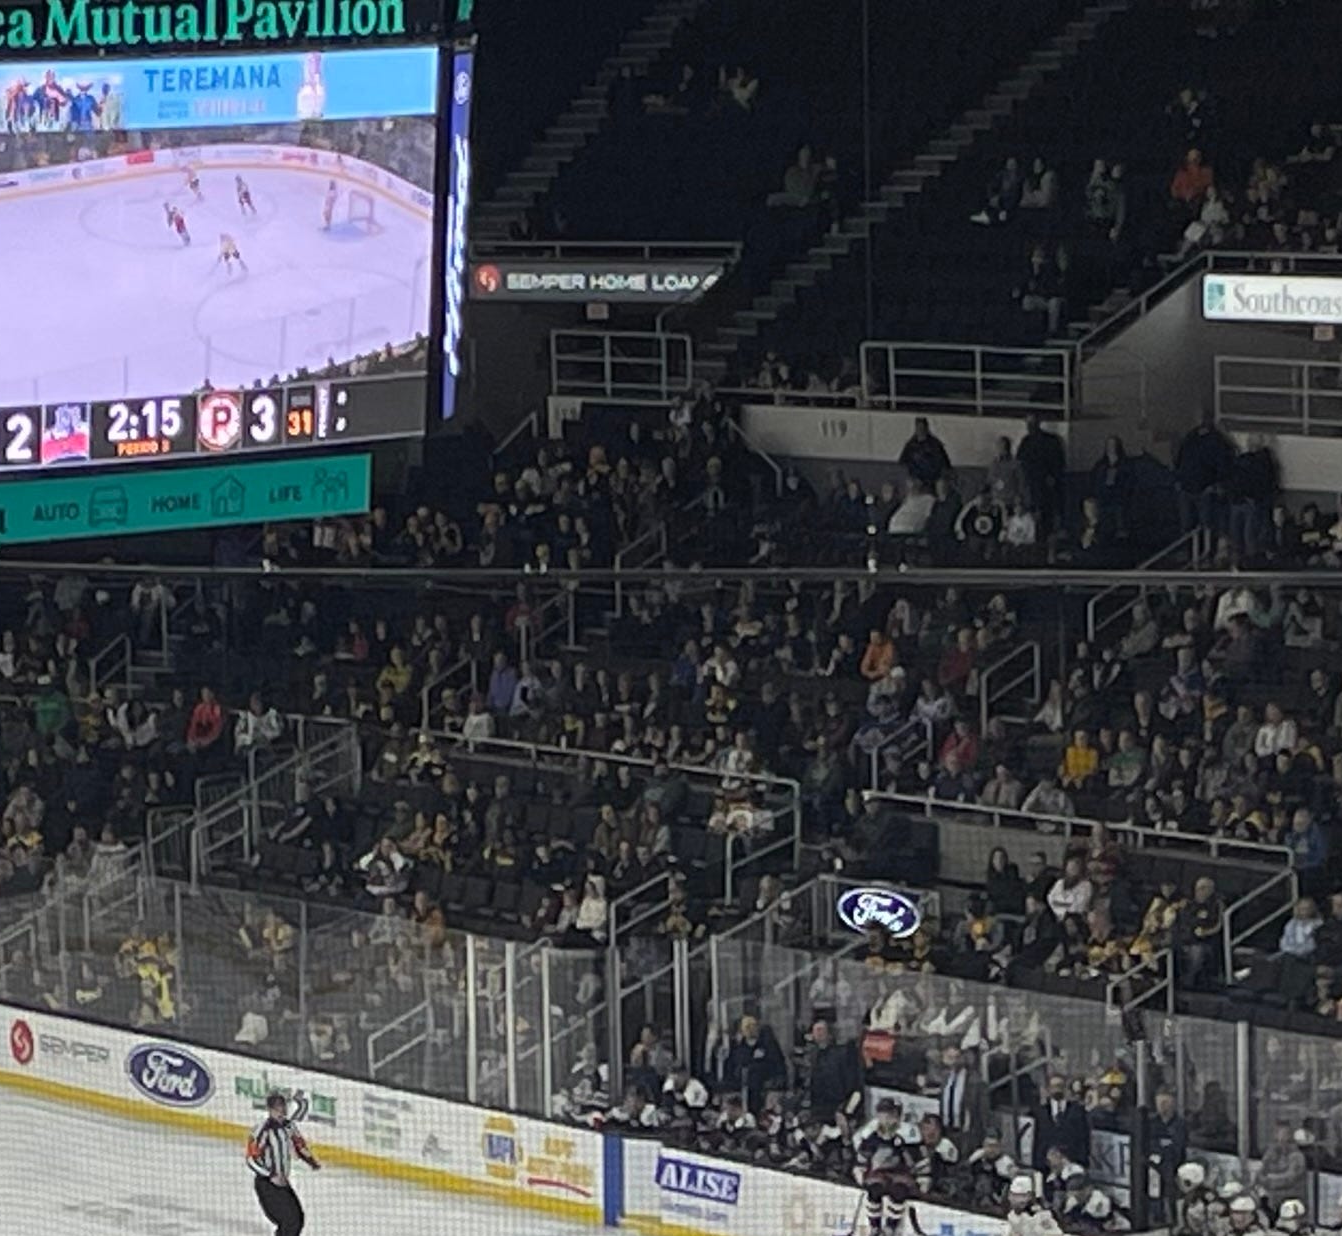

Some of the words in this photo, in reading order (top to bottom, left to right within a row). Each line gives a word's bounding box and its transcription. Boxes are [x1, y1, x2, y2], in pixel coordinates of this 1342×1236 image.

[41, 0, 217, 48] Mutual
[222, 0, 406, 43] Pavilion
[143, 63, 282, 93] TEREMANA
[507, 273, 585, 290] SEMPER
[589, 273, 647, 291] HOME
[5, 413, 33, 461] 2
[107, 401, 181, 442] 2:15
[250, 395, 276, 443] 3
[287, 408, 313, 437] 31
[821, 418, 848, 438] 119
[32, 502, 81, 523] AUTO
[150, 492, 202, 514] HOME
[269, 484, 303, 502] LIFE
[659, 1162, 738, 1200] ALISE
